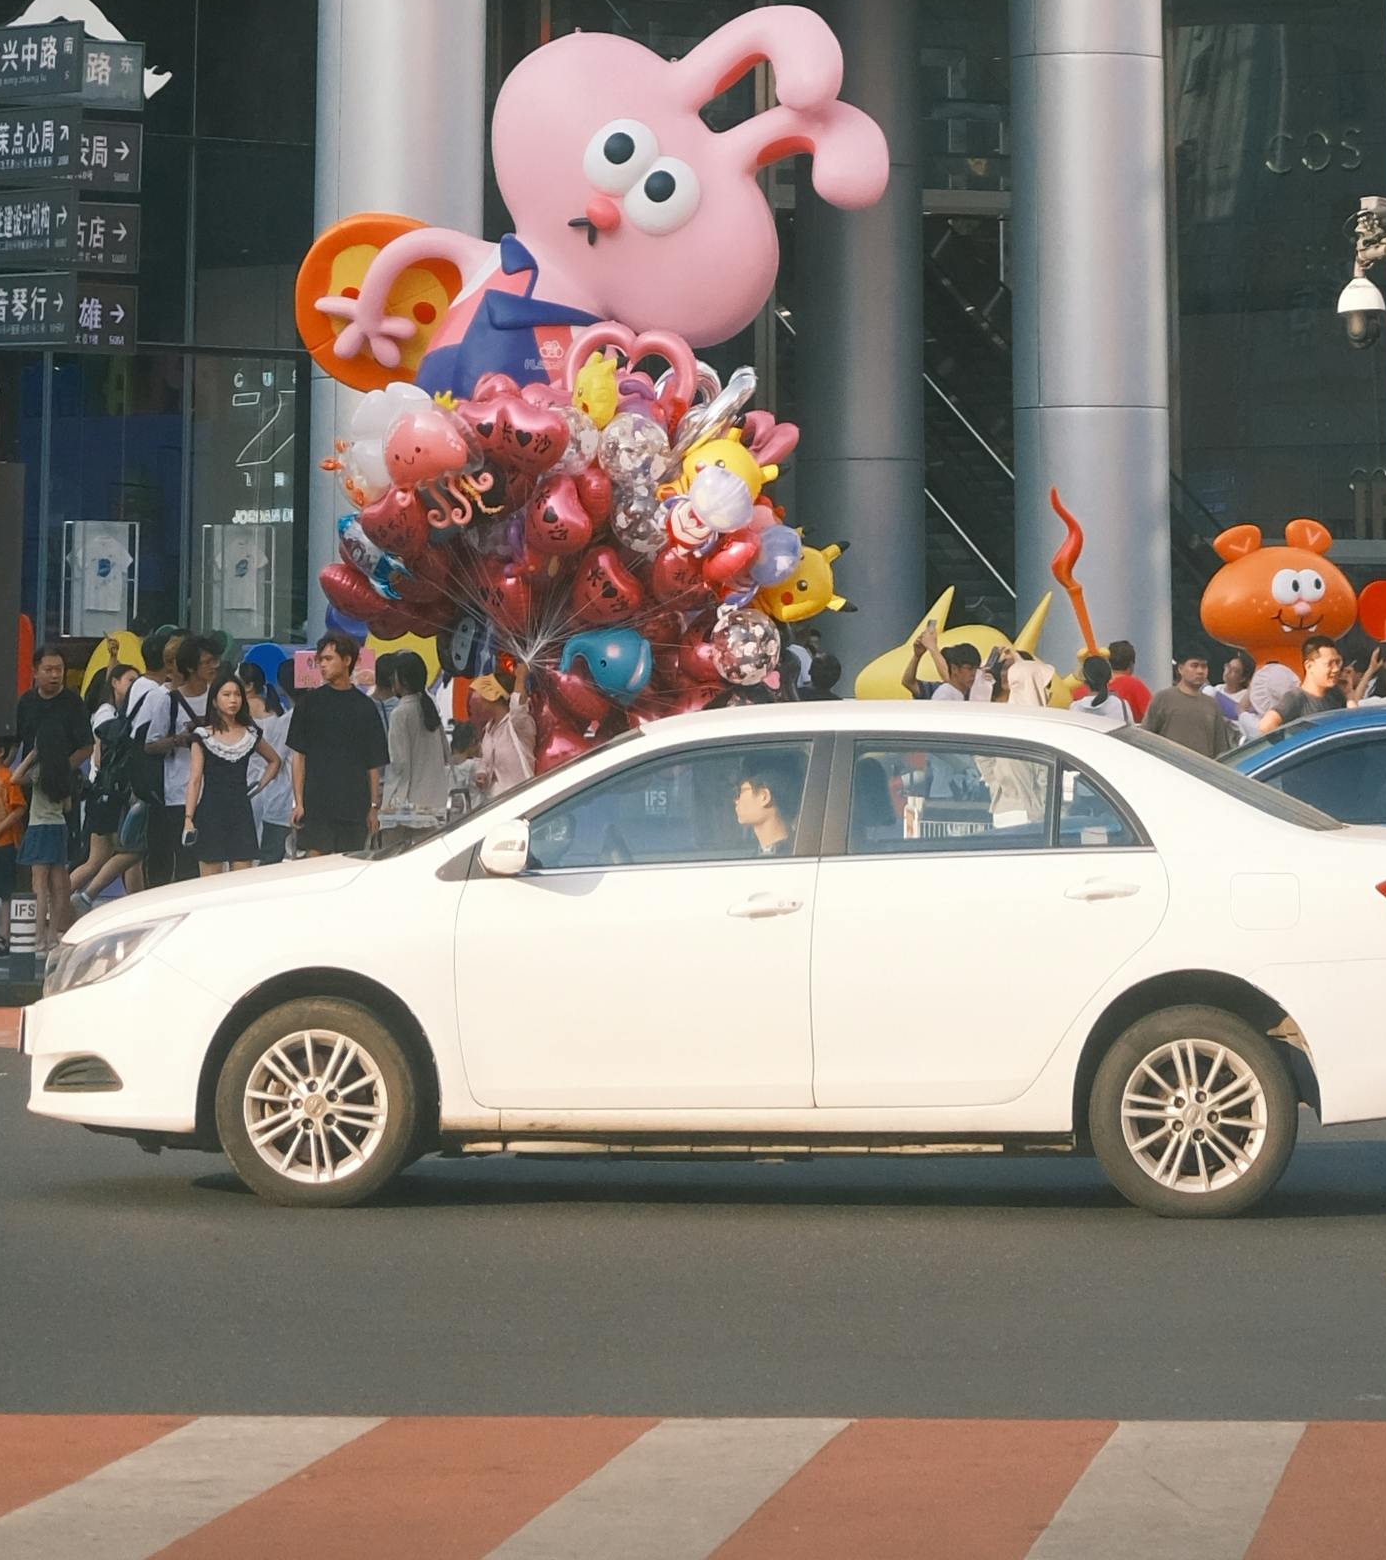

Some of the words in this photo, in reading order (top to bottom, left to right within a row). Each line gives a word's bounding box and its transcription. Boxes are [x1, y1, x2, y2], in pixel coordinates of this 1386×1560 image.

[63, 36, 75, 55] 南
[644, 790, 667, 807] IFS
[15, 903, 36, 917] IFS
